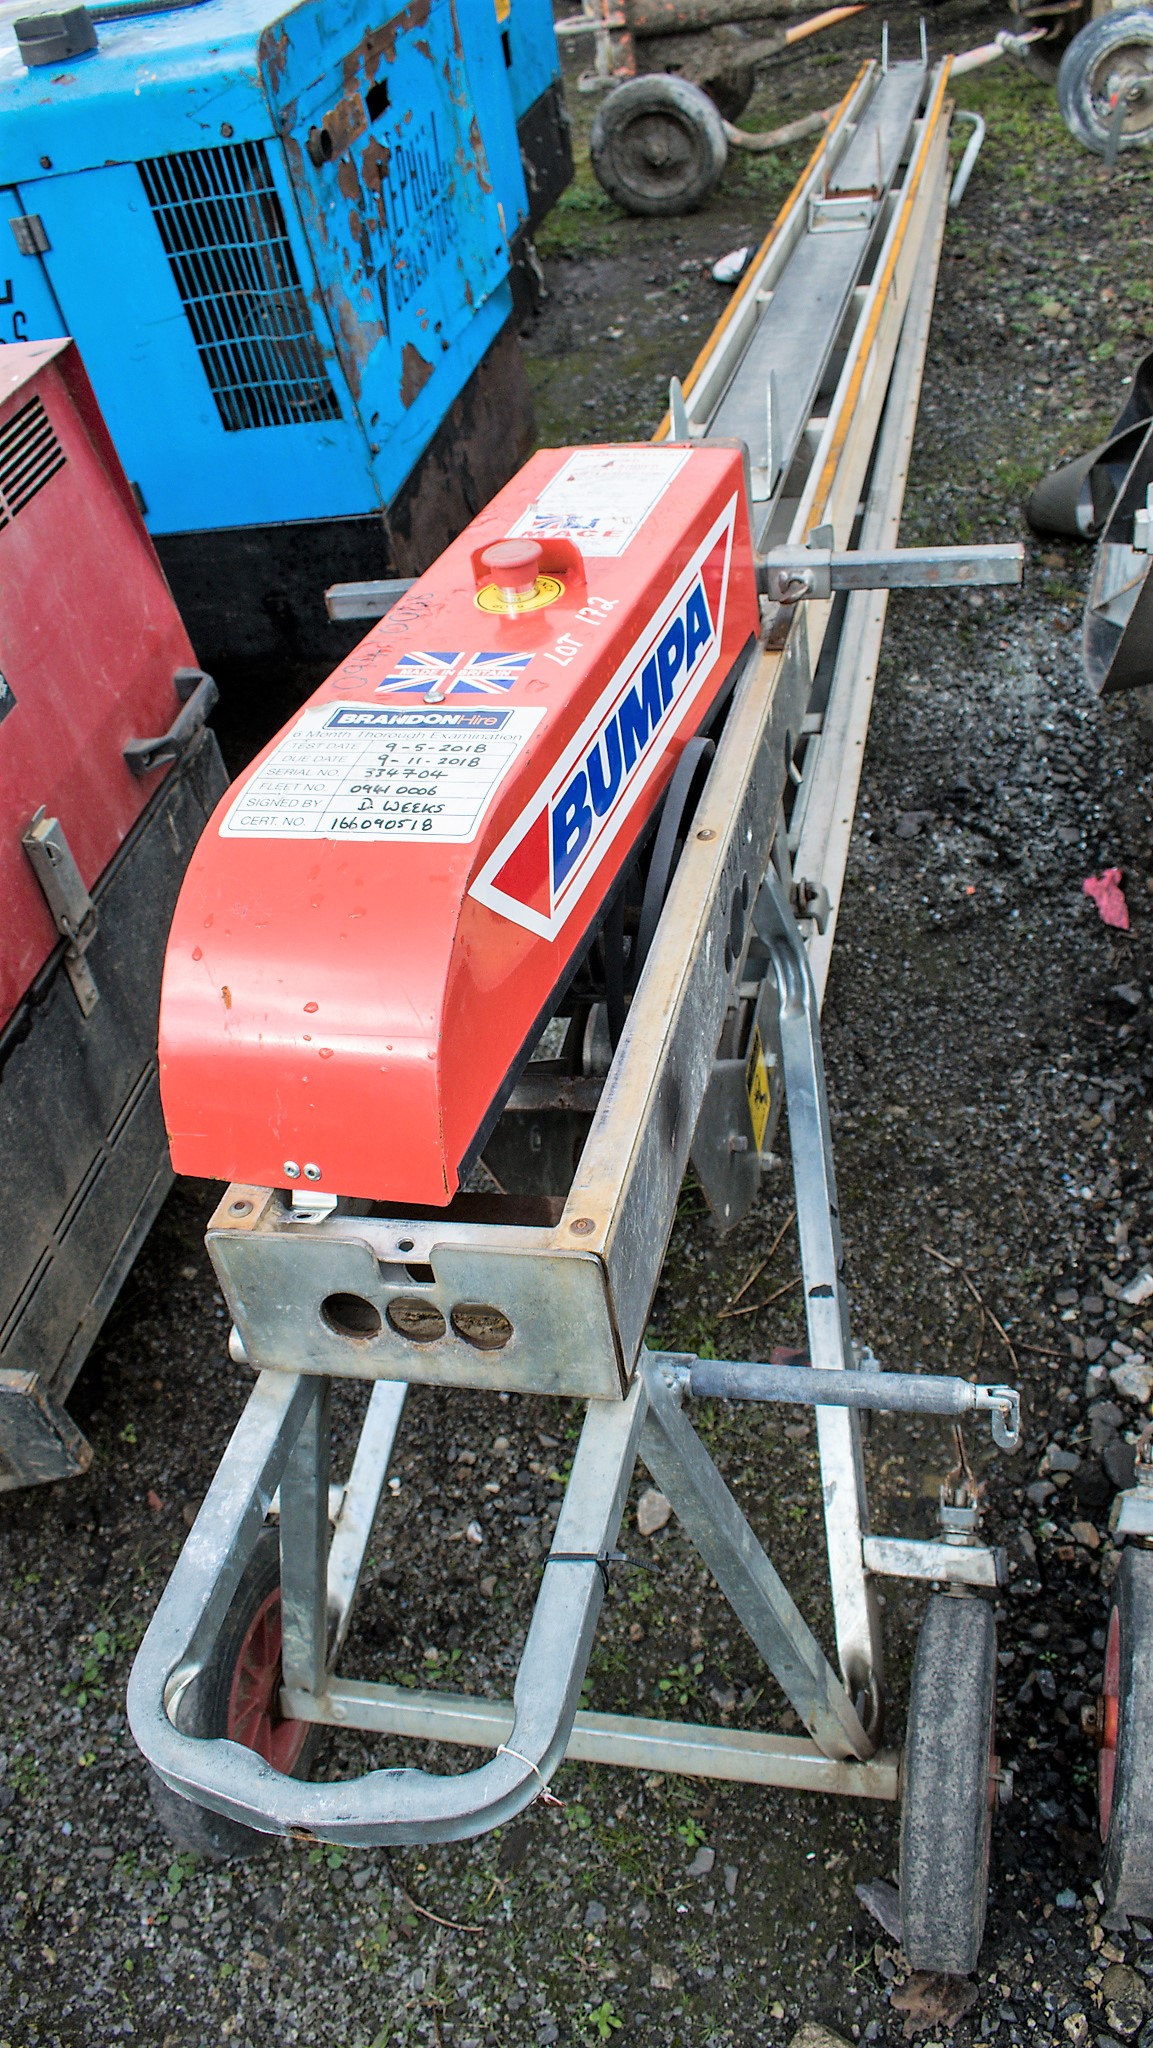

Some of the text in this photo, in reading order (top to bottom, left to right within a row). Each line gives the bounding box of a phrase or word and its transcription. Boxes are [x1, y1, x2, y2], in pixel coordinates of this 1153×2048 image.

[520, 530, 624, 538] MACE
[543, 632, 584, 667] LOT
[574, 596, 619, 626] 172
[400, 668, 513, 677] MADE IN BRITAIN
[292, 730, 523, 742] 6 Month Thorough Examination
[552, 583, 711, 895] BUMPA
[291, 742, 321, 750] TEST
[326, 742, 361, 750] DATE
[313, 755, 348, 763] DATE
[266, 767, 449, 779] SERIAL NO. 334704
[259, 782, 303, 791] FLEET
[303, 783, 327, 792] NO.
[246, 798, 300, 808] SIGNED
[302, 799, 323, 808] BY
[382, 800, 446, 814] WEEKS
[240, 815, 433, 832] CERT. NO. 166090518
